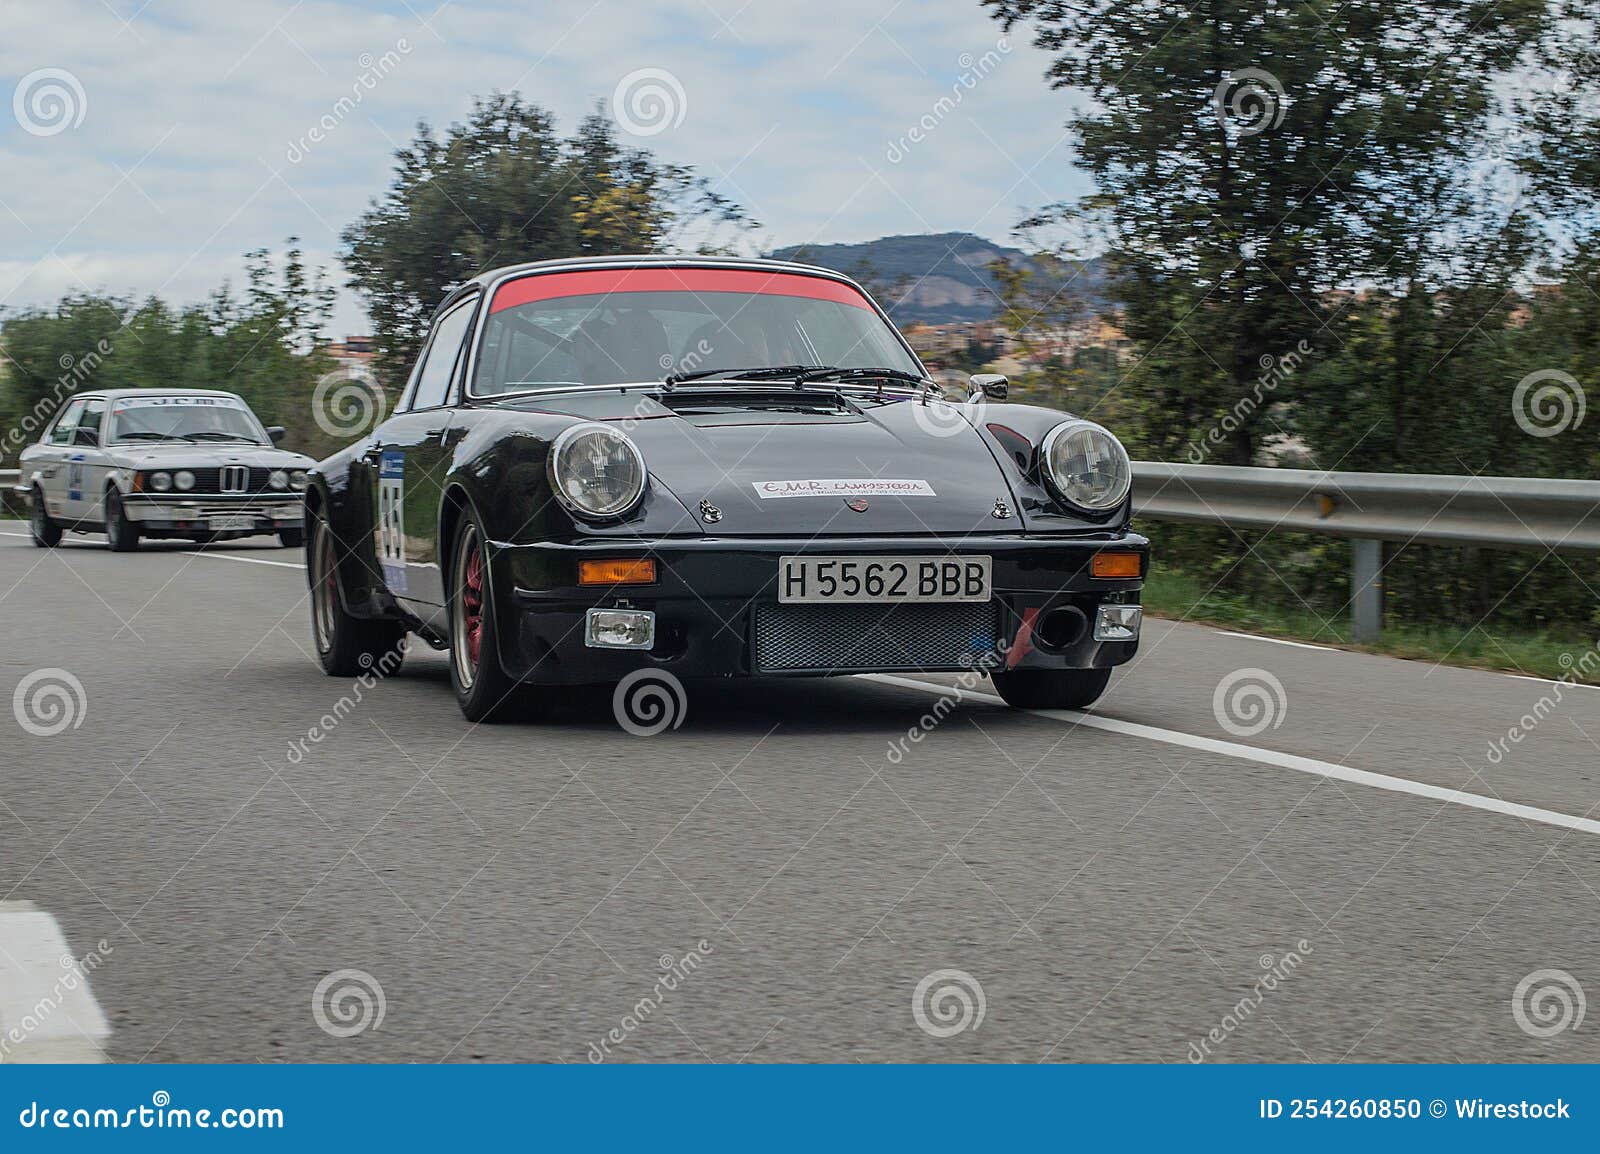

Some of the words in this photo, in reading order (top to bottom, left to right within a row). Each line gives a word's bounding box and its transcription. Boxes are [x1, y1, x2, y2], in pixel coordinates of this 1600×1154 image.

[786, 563, 806, 597] H
[817, 562, 907, 597] 5562
[919, 562, 984, 596] BBB
